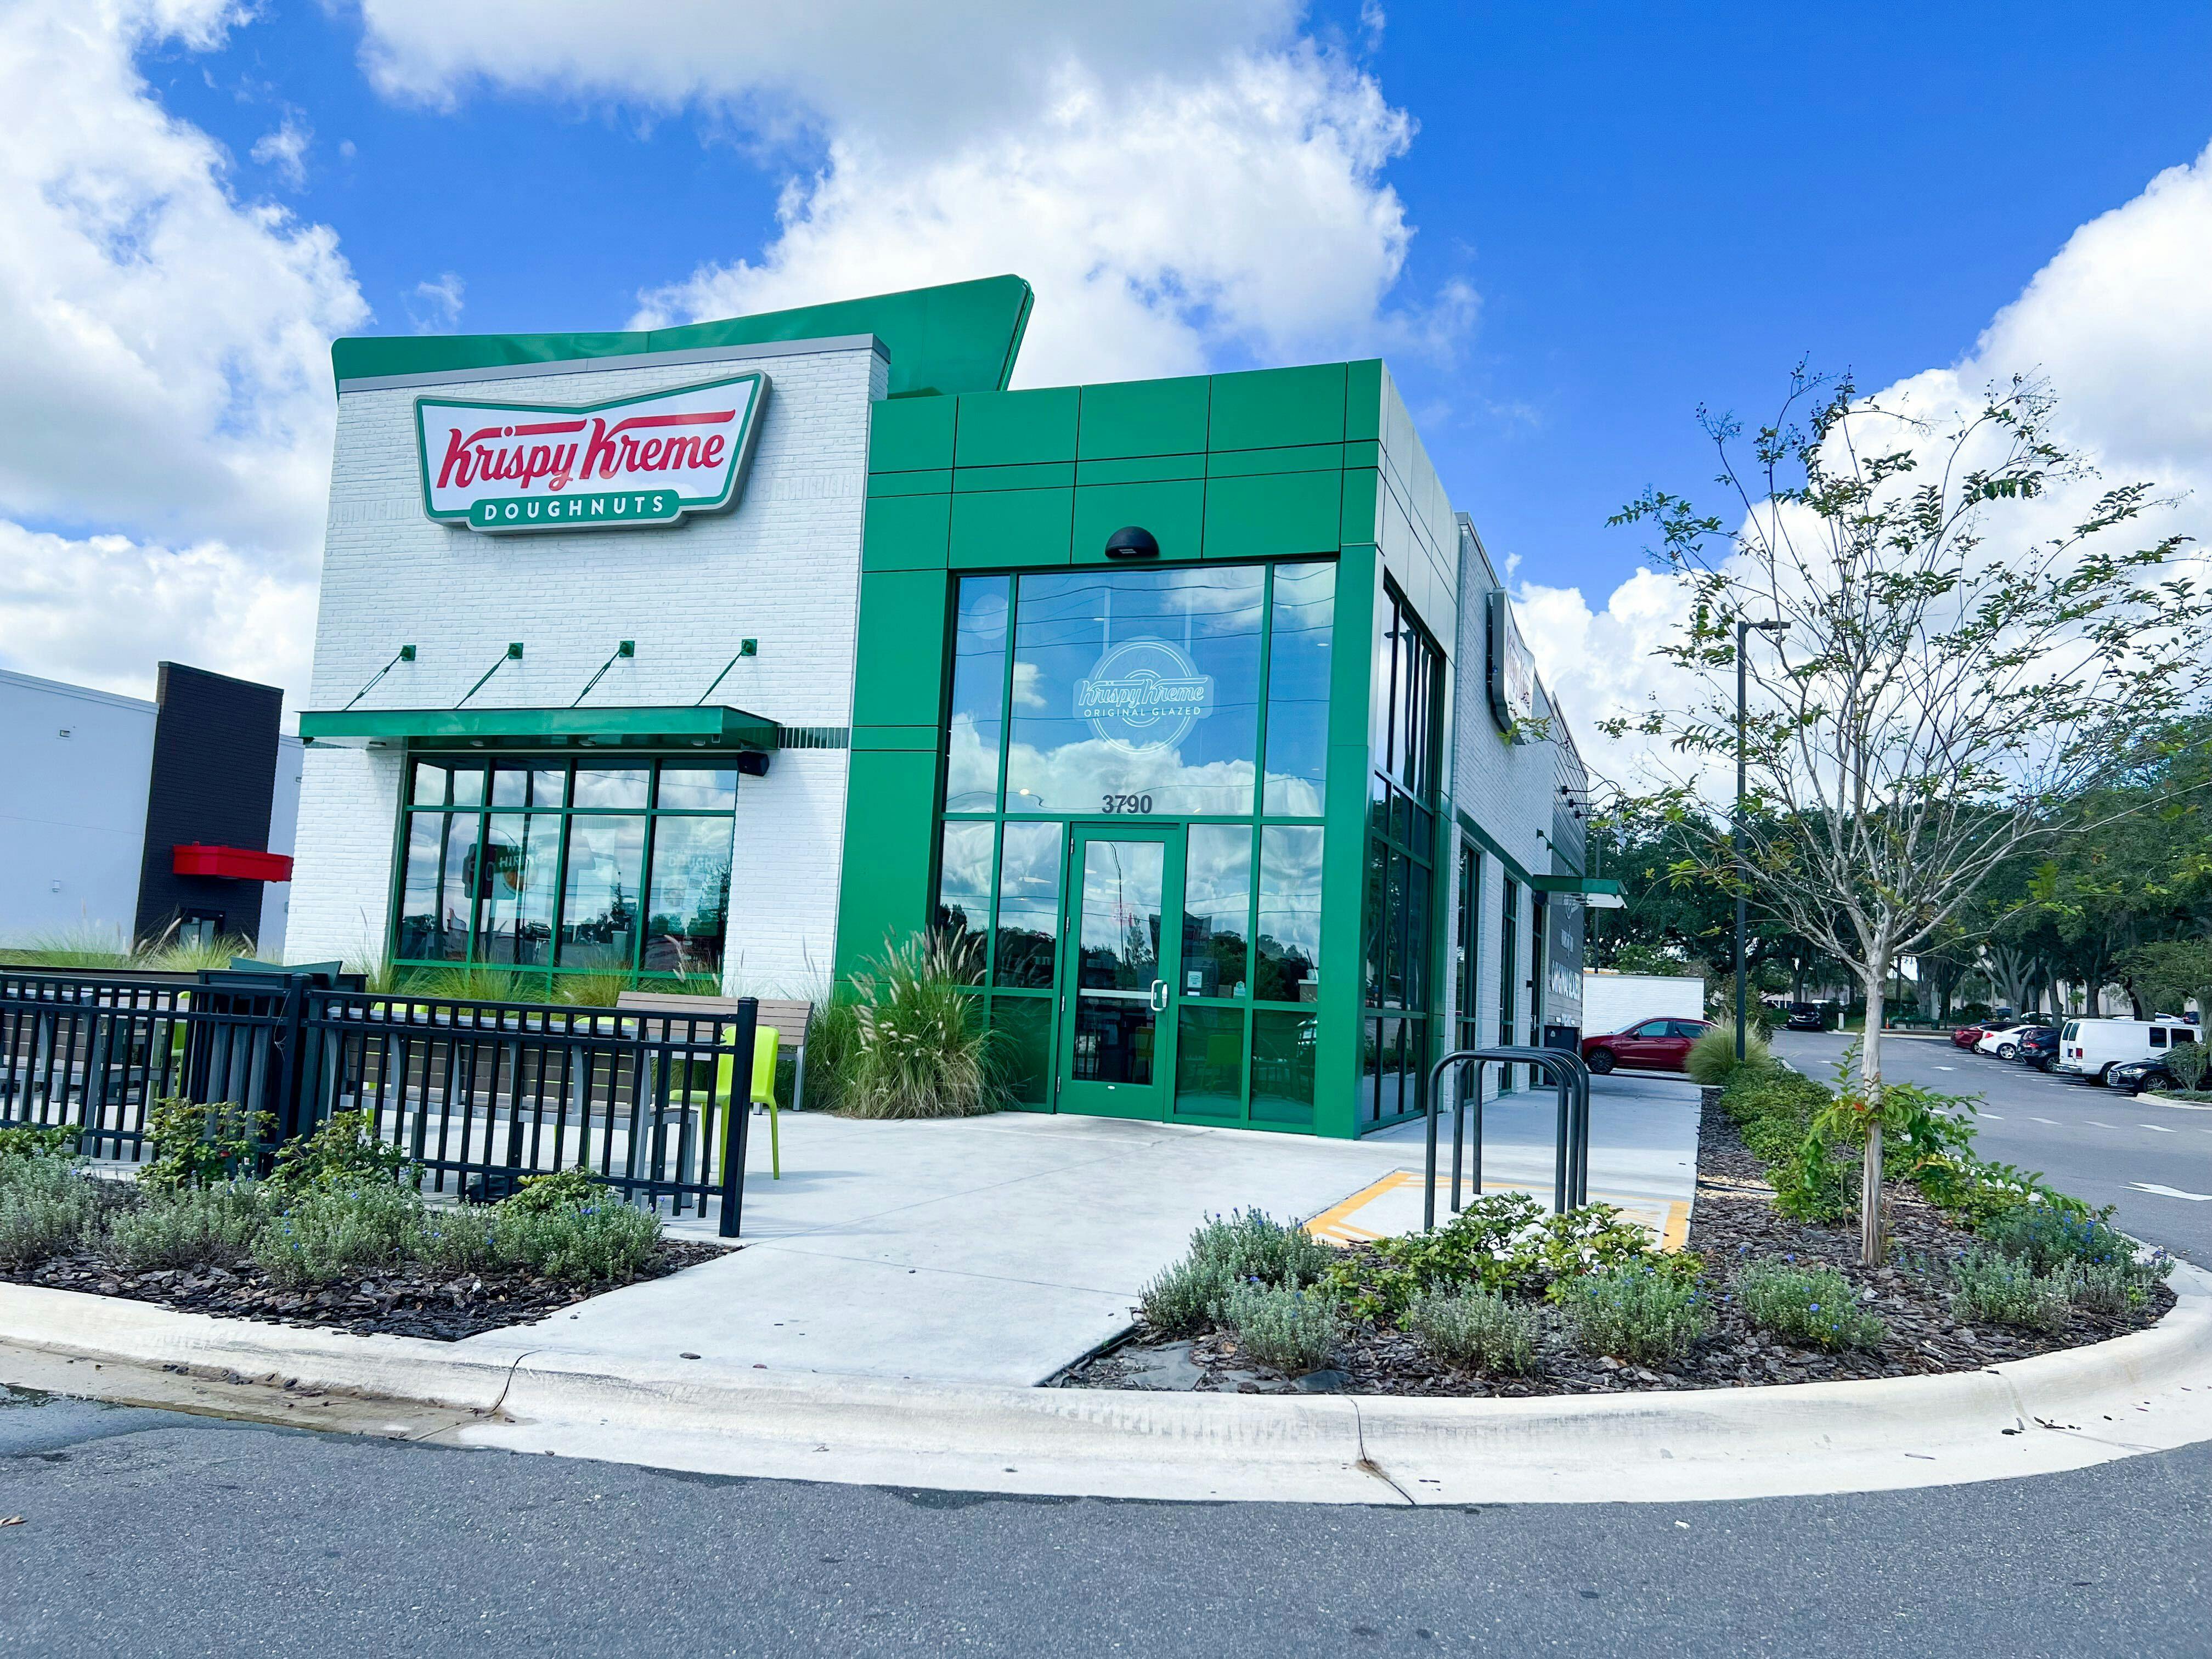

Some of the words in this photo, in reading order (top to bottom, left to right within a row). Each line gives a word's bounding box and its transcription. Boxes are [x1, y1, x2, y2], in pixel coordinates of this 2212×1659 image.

[437, 418, 586, 491] Krispy
[579, 409, 736, 479] Kreme
[484, 495, 663, 521] DOUGHNUTS
[1079, 679, 1145, 708] Krispy
[1142, 677, 1207, 704] Kreme
[1084, 708, 1146, 718] ORIGINAL
[1152, 707, 1201, 716] GLAZED
[1102, 795, 1152, 814] 3790
